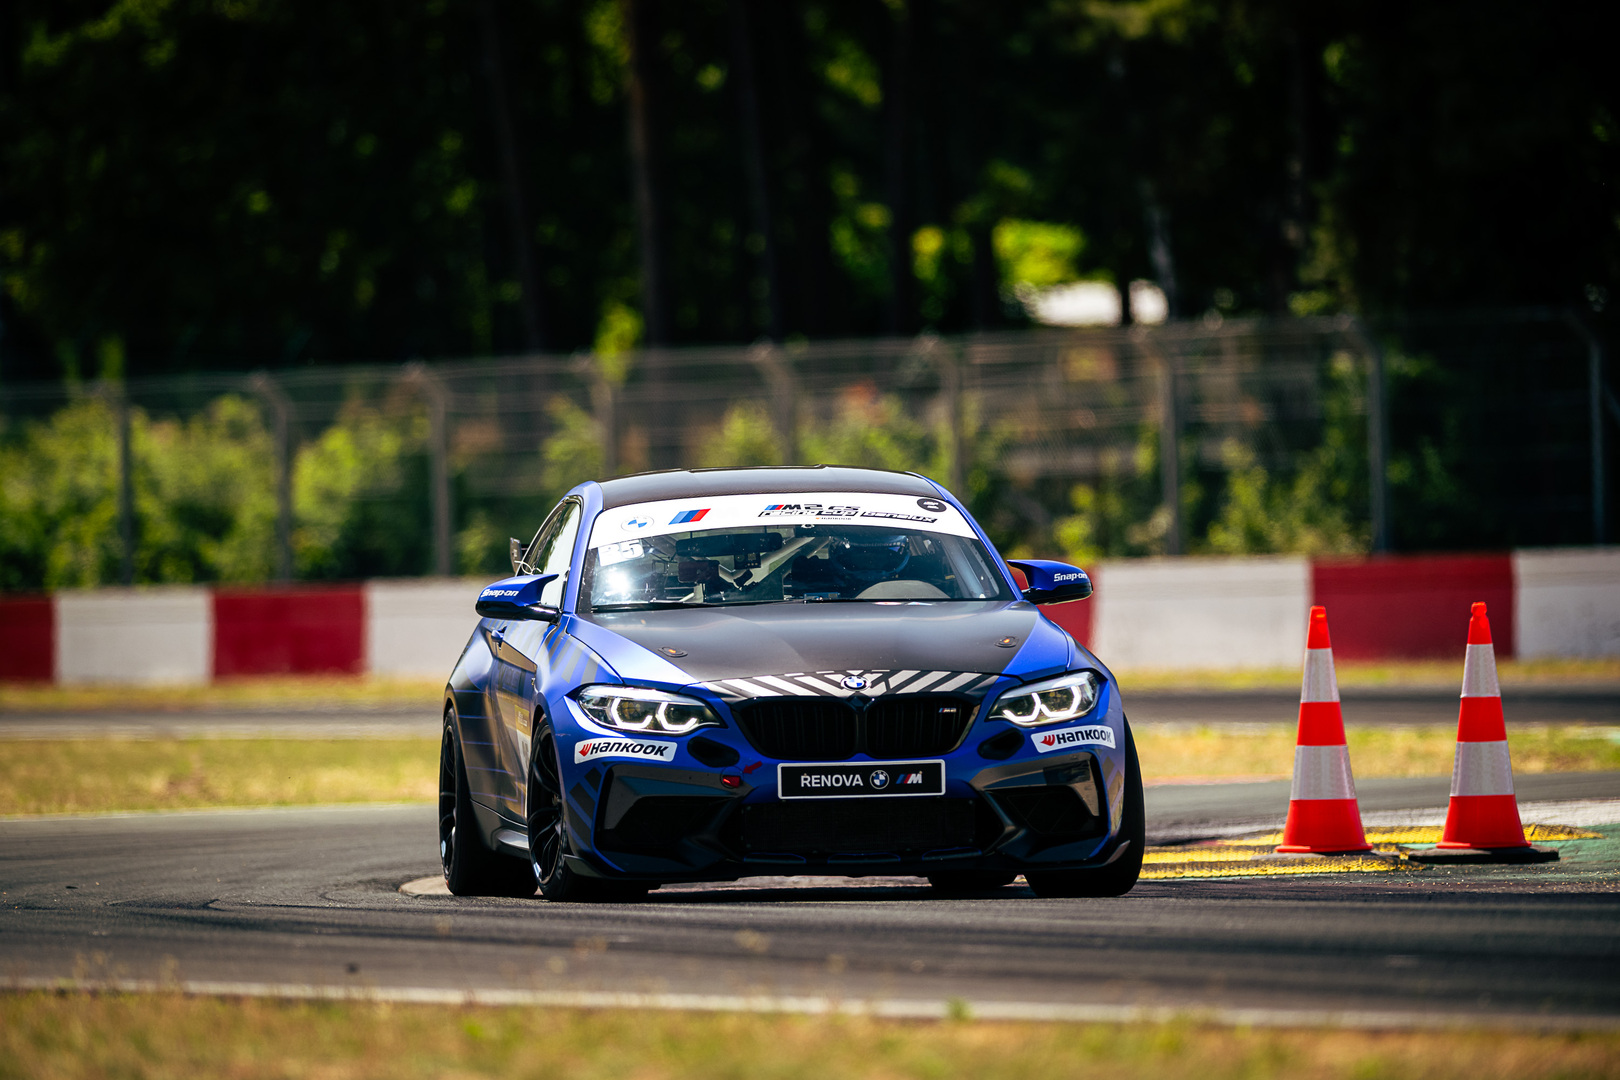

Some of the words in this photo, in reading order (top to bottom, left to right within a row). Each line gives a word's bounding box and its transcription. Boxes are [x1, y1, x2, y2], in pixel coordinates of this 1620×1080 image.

[1053, 572, 1088, 582] Snap-on
[480, 588, 520, 598] Snap-on
[800, 773, 864, 788] RENOVA
